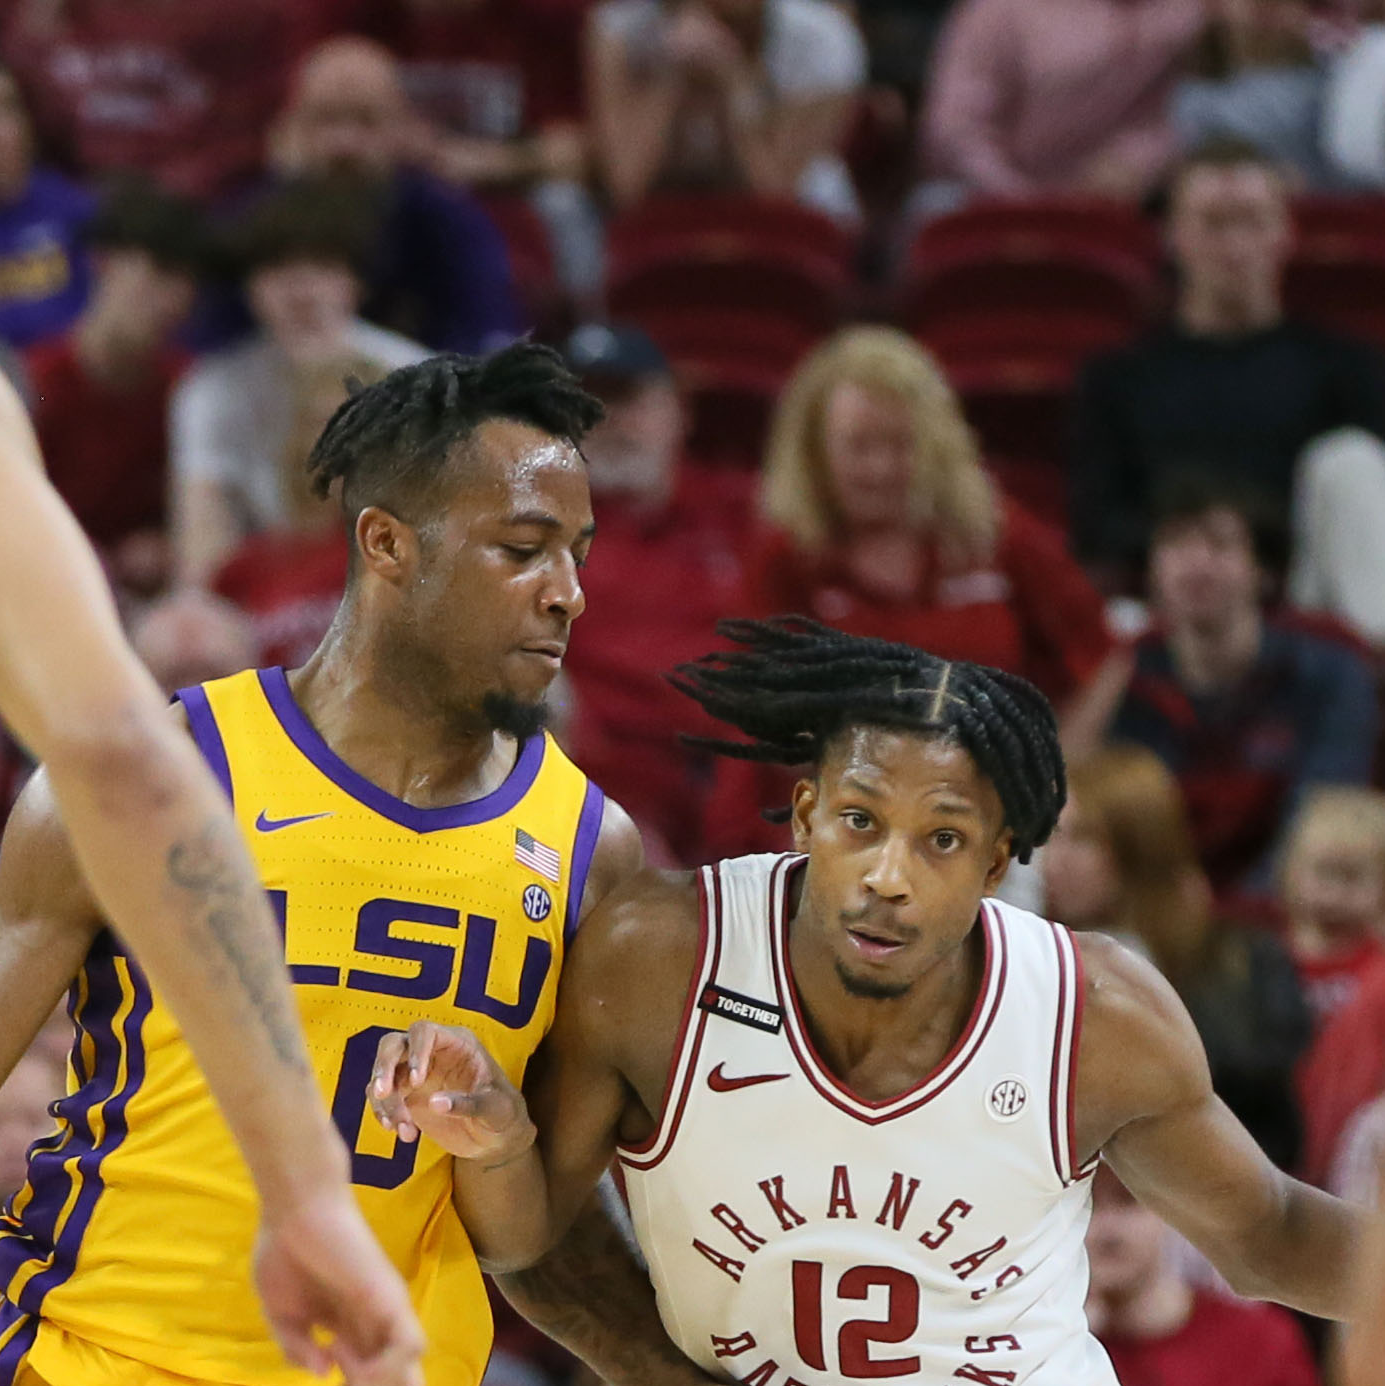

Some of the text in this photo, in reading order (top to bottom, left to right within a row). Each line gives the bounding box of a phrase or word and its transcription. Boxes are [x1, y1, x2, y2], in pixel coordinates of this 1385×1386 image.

[264, 888, 553, 1030] LSU
[523, 885, 551, 920] SEC
[717, 995, 781, 1027] TOGETHER
[692, 1165, 1025, 1301] ARKANSAS
[791, 1259, 922, 1380] 12
